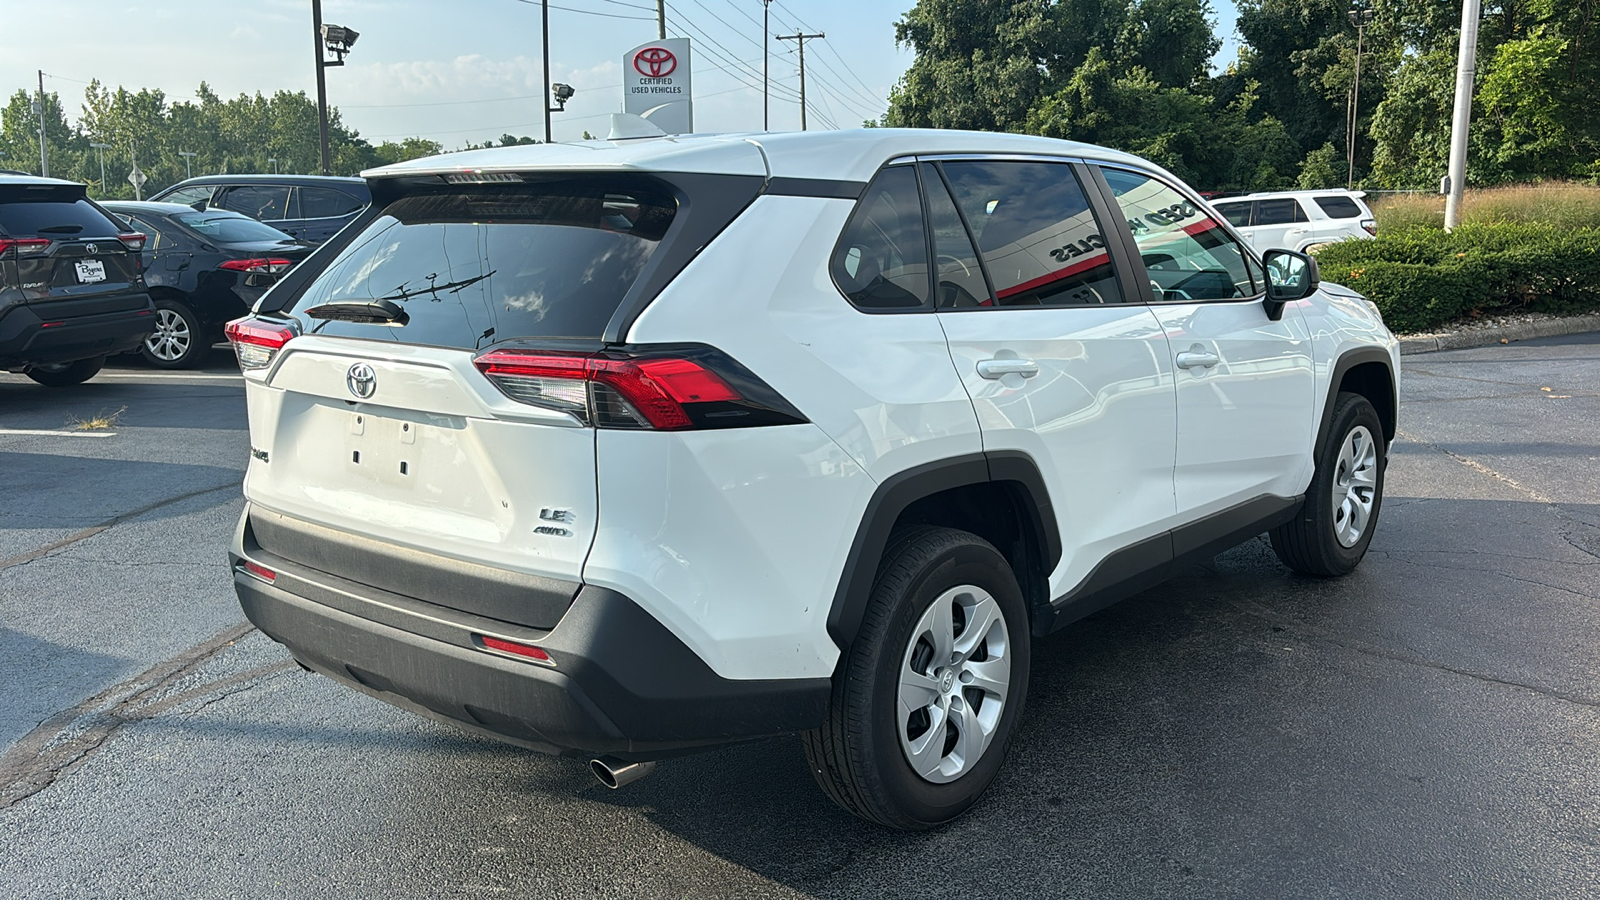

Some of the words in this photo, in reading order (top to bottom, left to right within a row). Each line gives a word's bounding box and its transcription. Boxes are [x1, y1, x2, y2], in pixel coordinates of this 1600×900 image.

[639, 77, 673, 85] CERTIFIED
[631, 86, 649, 94] USED
[650, 86, 682, 94] VEHICLES
[539, 508, 568, 522] LE
[532, 525, 568, 536] AWD
